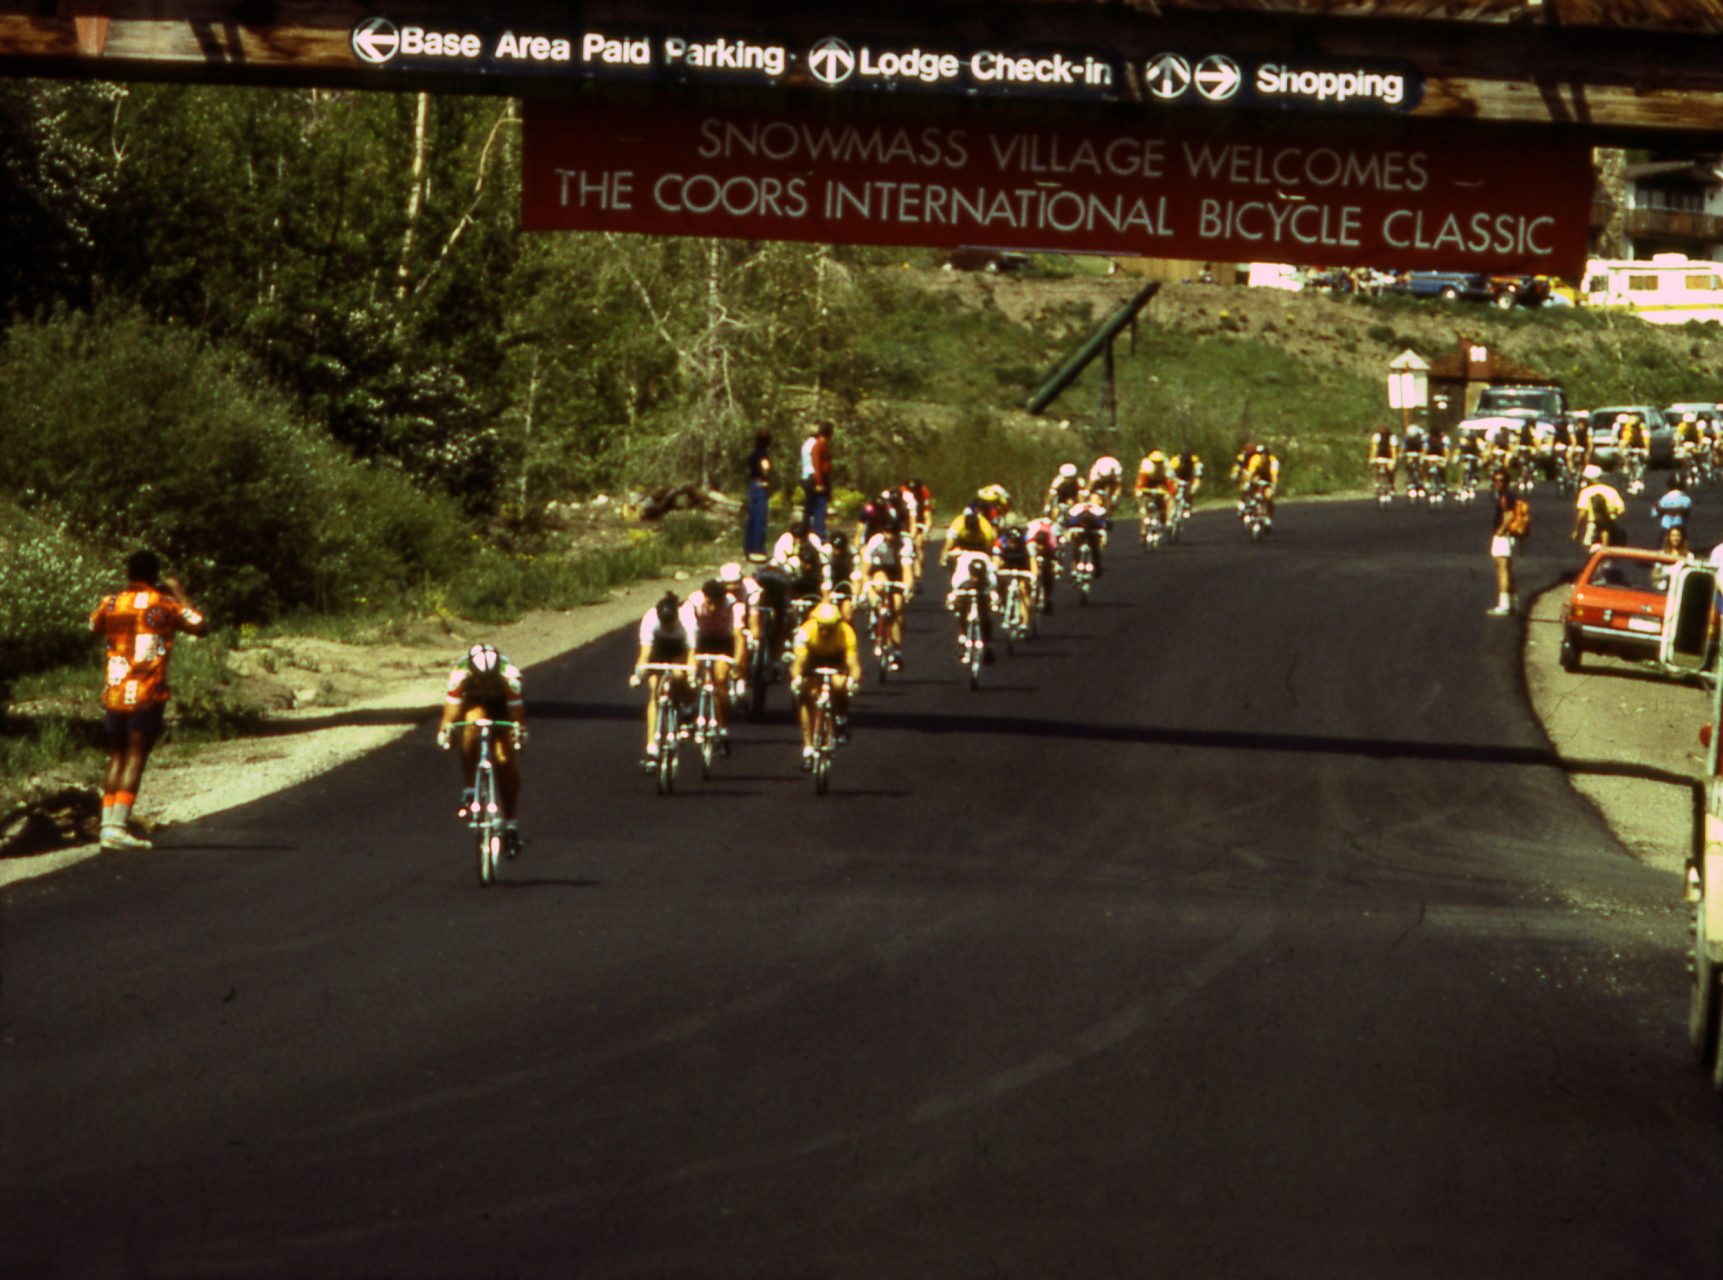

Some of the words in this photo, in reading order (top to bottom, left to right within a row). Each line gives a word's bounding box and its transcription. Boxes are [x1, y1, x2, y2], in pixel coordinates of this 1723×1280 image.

[401, 26, 481, 57] Base
[495, 31, 571, 61] Area
[583, 33, 650, 64] Paid
[665, 37, 784, 75] Parking
[860, 47, 959, 82] Lodge
[971, 50, 1112, 84] Check-in
[1256, 63, 1404, 103] Shopping
[699, 119, 968, 169] SNOWMASS
[990, 133, 1165, 179] VILLAGE
[1182, 141, 1429, 191] WELCOMES
[554, 168, 632, 210] THE
[654, 174, 808, 218] COORS
[824, 181, 1174, 236] INTERNATIONAL
[1199, 198, 1362, 247] BICYCLE
[1382, 209, 1554, 255] CLASSIC
